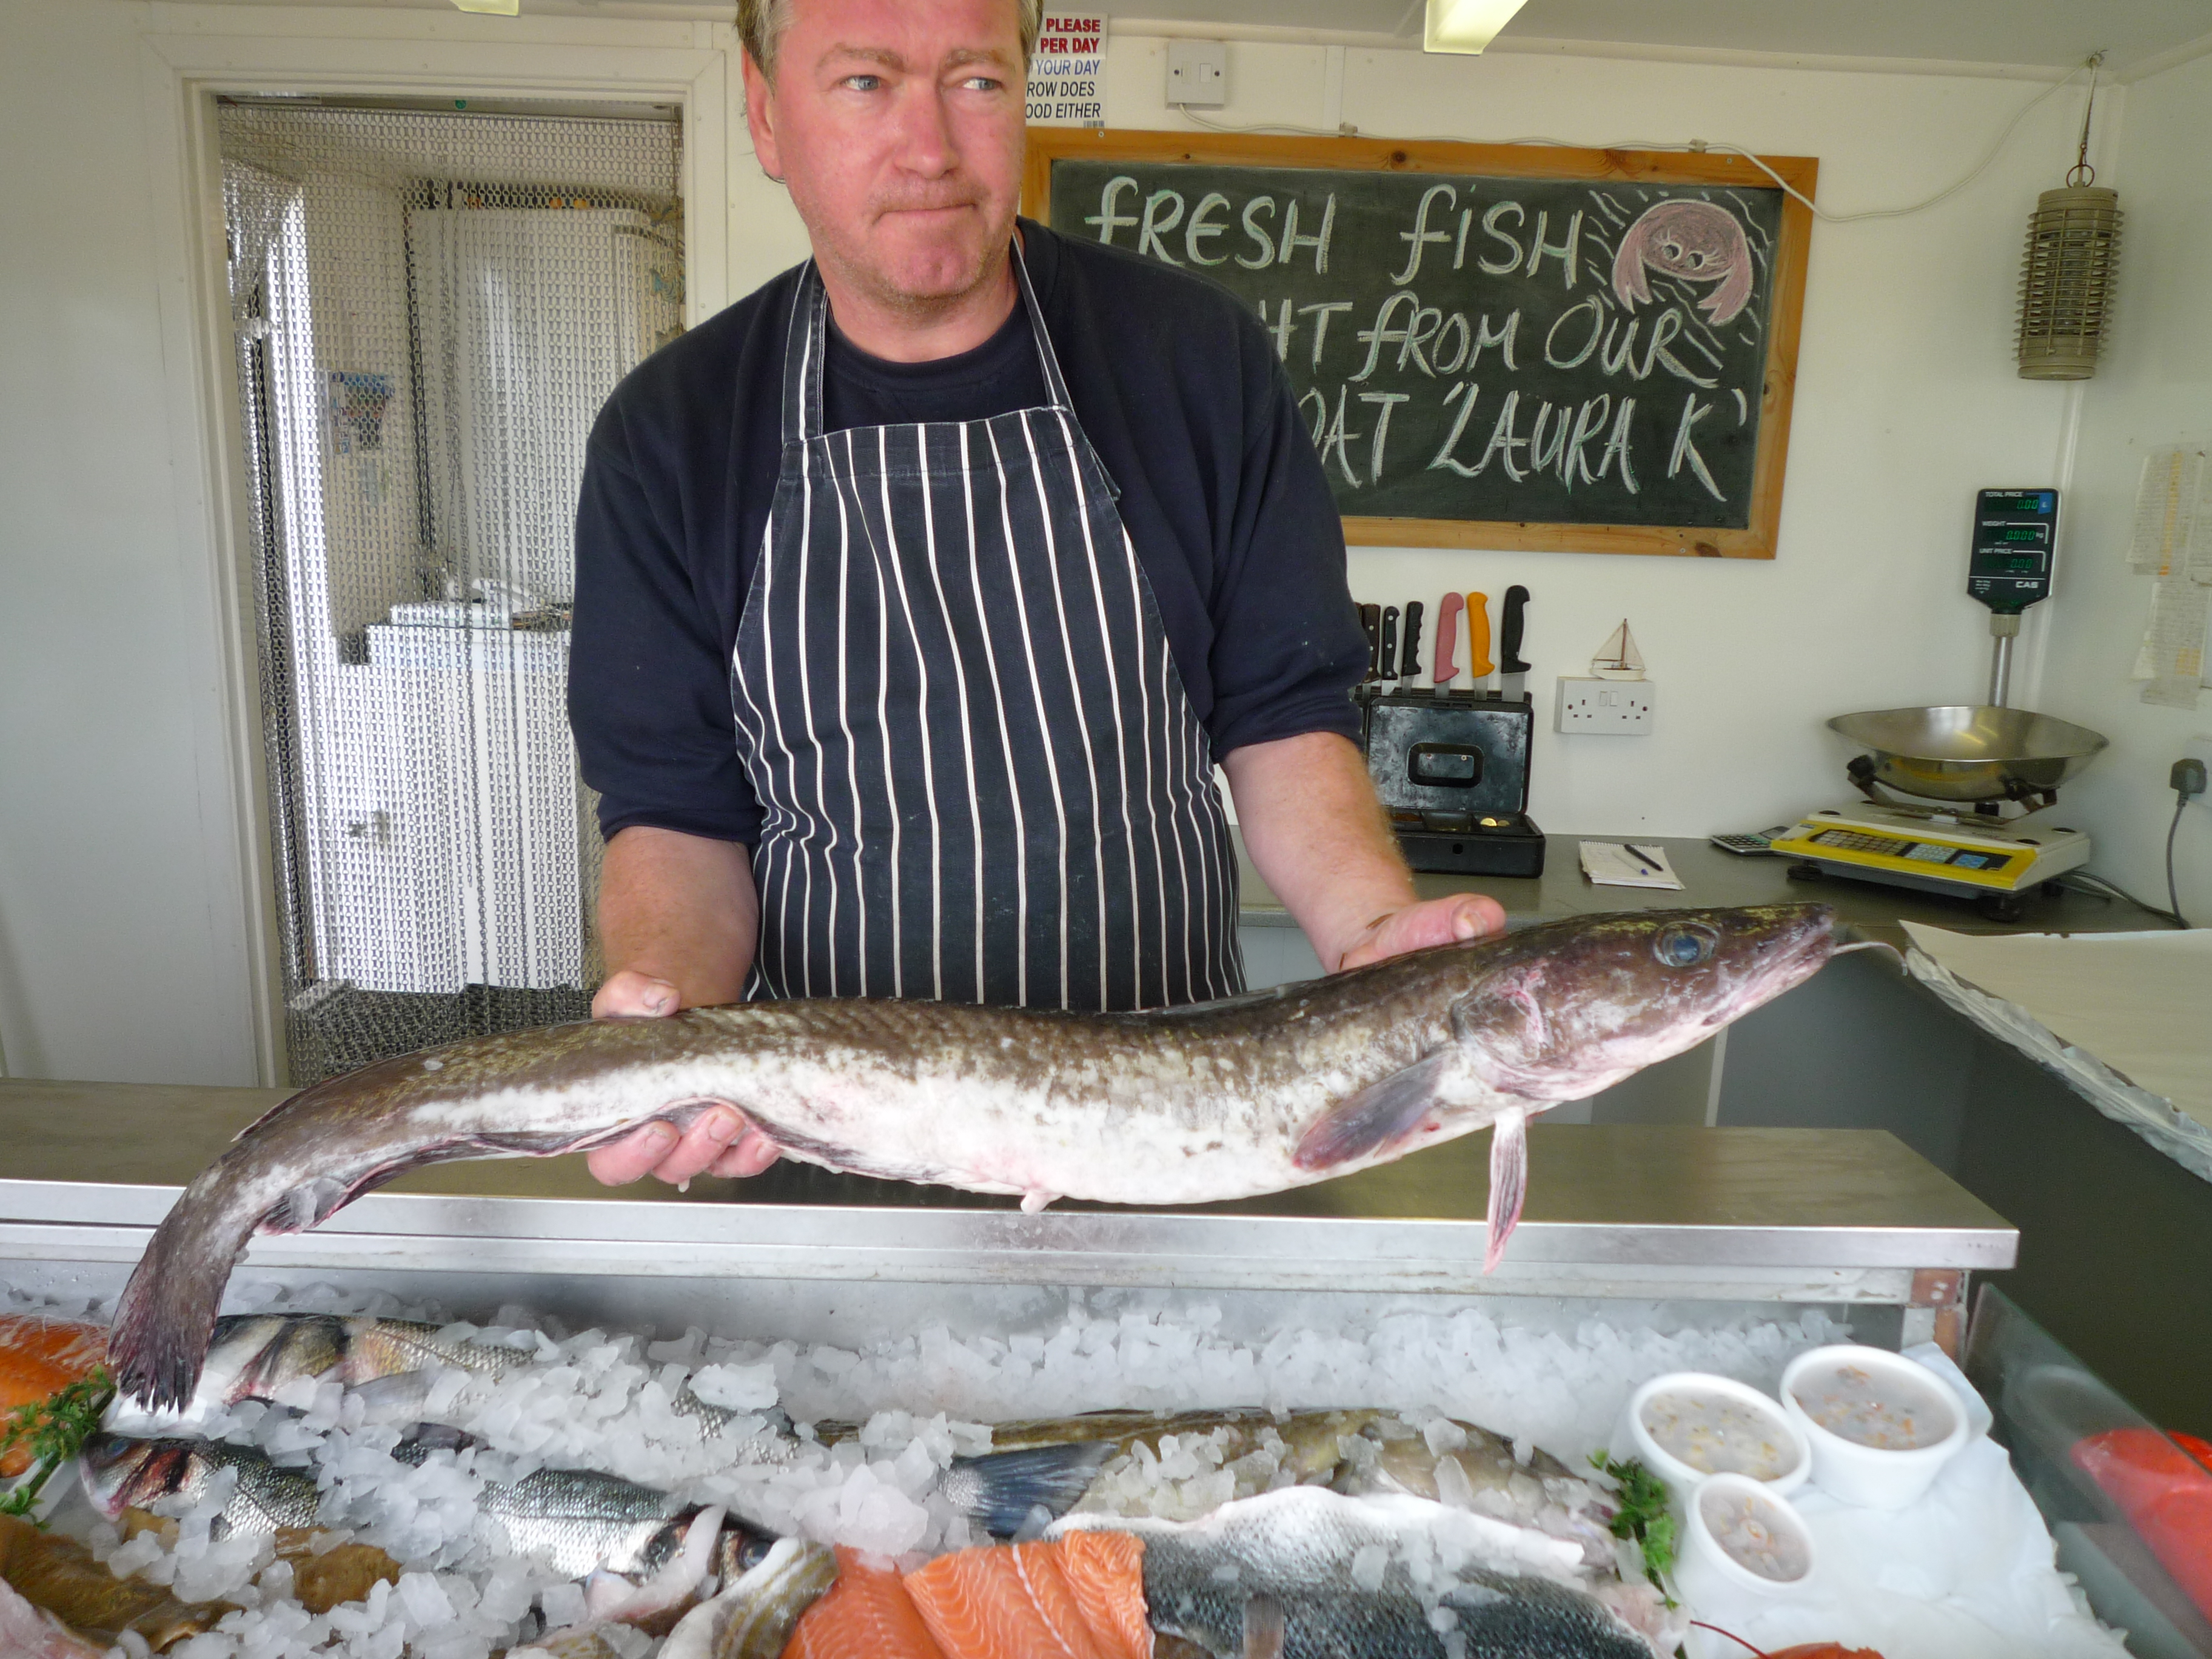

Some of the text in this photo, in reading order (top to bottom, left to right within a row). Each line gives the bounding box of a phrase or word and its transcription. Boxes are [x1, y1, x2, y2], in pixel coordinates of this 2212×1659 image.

[1046, 18, 1101, 33] PLEASE
[1041, 38, 1100, 53] PER DAY
[1036, 59, 1070, 75] YOUR
[1074, 59, 1101, 75] DAY
[1061, 81, 1094, 97] DOES
[1056, 103, 1101, 118] EITHER
[1544, 295, 1719, 389] OUR
